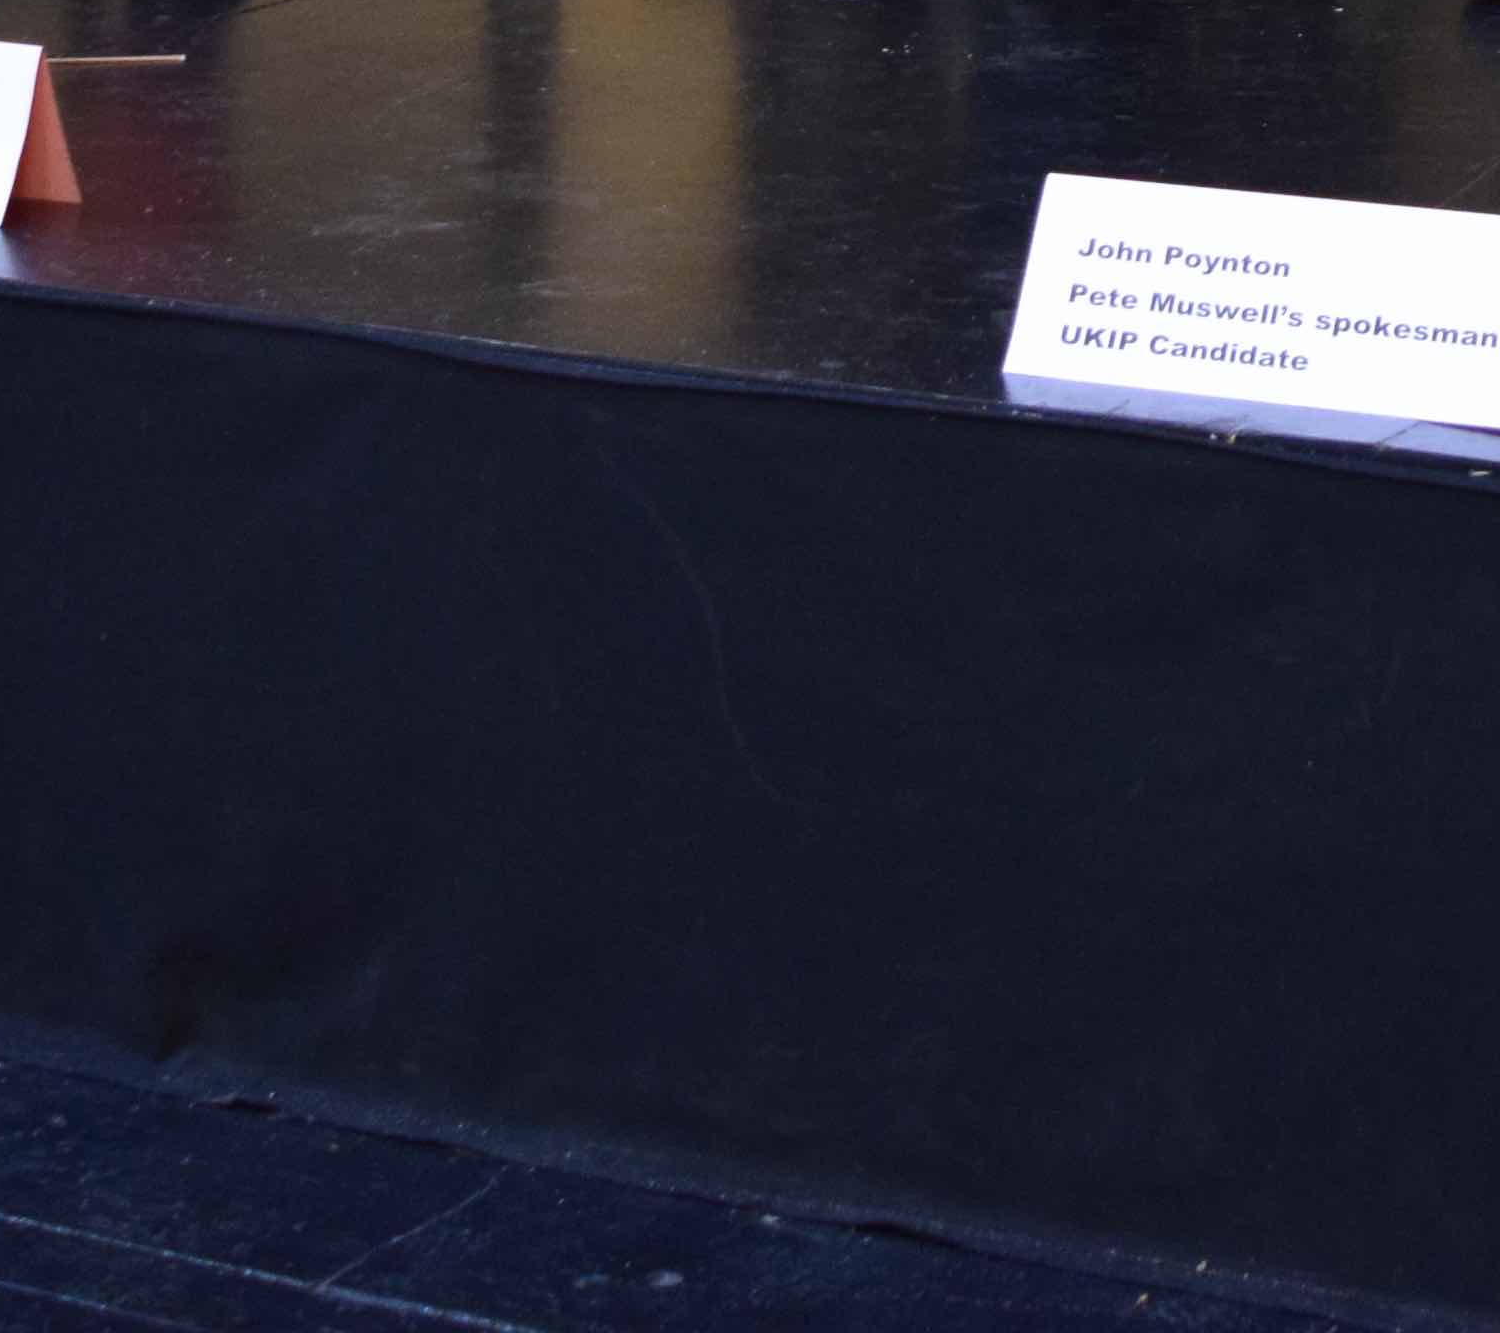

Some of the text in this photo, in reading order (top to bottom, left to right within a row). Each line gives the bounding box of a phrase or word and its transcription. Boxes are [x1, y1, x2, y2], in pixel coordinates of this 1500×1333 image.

[1077, 237, 1291, 278] John Poynton
[1067, 282, 1139, 310] Pete
[1060, 324, 1309, 372] UKIP Candidate
